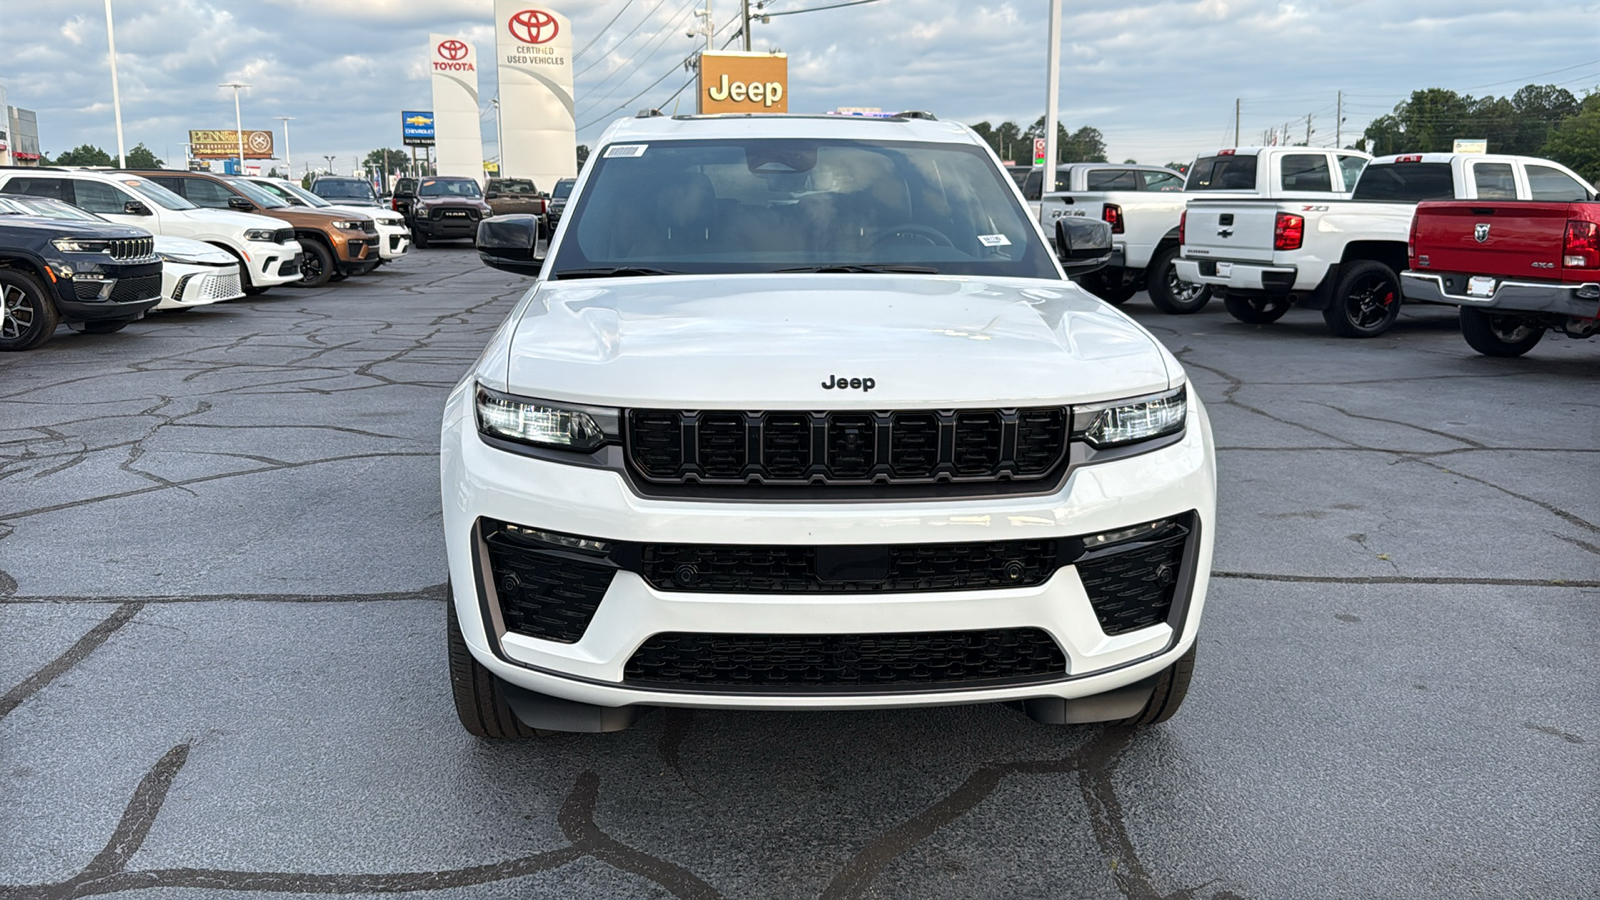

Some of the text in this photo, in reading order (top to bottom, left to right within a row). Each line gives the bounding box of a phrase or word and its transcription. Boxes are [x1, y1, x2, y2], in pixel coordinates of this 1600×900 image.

[517, 46, 554, 55] CERTIFIED
[507, 56, 564, 65] USED VEHICLES
[433, 62, 475, 71] TOYOTA
[708, 74, 783, 108] Jeep
[191, 131, 225, 142] PENN
[1051, 209, 1086, 218] RAM
[821, 374, 876, 392] Jeep
